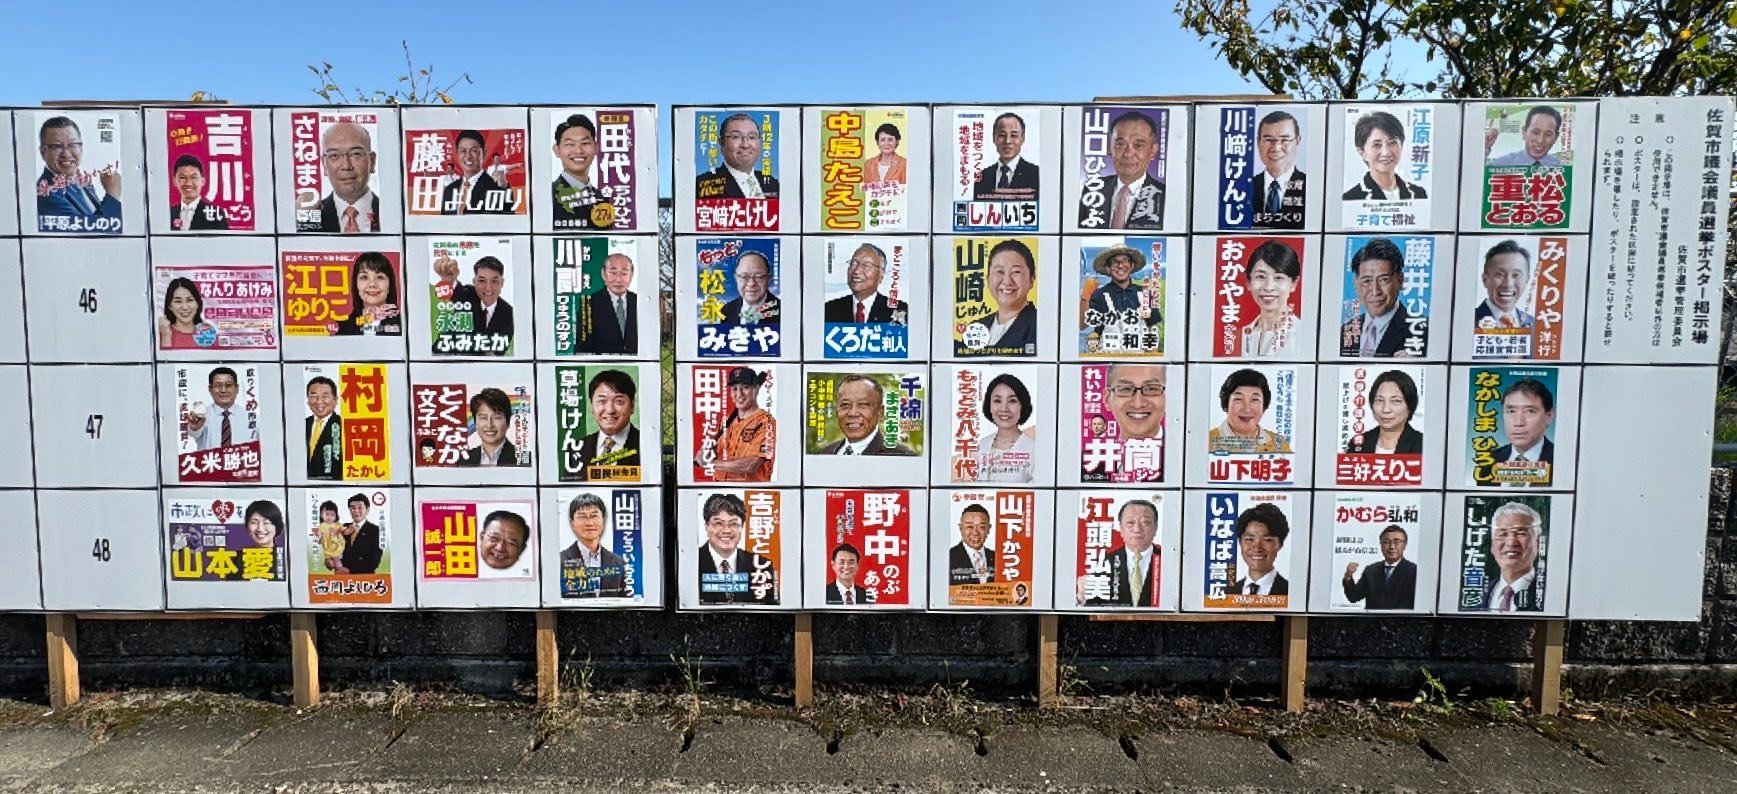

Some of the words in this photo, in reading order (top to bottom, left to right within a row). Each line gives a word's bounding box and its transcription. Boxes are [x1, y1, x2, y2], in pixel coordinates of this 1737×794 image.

[205, 113, 245, 203] 吉川
[294, 116, 320, 208] さねまつ
[972, 121, 984, 183] 地域をつくり
[1409, 108, 1431, 182] 江原新子
[410, 133, 447, 212] 藤田
[600, 124, 632, 228] 田代ちかひさ
[823, 111, 865, 230] 中島たえこ
[1080, 109, 1110, 228] 山口ひろのぶ
[444, 189, 523, 212] よしのり
[1489, 173, 1566, 203] 重松
[44, 216, 122, 231] 平原よしのり
[203, 204, 252, 221] せいごう
[969, 203, 1037, 227] しんいち
[1252, 212, 1302, 223] まちづくり
[1356, 214, 1415, 227] 子育て福祉
[1485, 202, 1565, 225] とおる
[1691, 108, 1724, 345] 佐賀市議会議員選挙ポスター掲示場
[200, 282, 233, 298] なんり
[236, 281, 273, 298] あけみ
[285, 263, 350, 296] 江口
[700, 269, 727, 324] 松永
[1219, 240, 1246, 323] おかやま
[1671, 244, 1688, 348] 佐賀市選挙管理委員会
[79, 288, 98, 313] 46
[287, 298, 350, 321] ゆりこ
[955, 302, 992, 319] じゅん
[1402, 238, 1432, 357] 藤井ひでき
[1084, 308, 1140, 327] なかお
[438, 333, 510, 353] ふみたか
[700, 326, 780, 354] みきや
[825, 325, 907, 355] くろだ利人
[1122, 333, 1159, 350] 和幸
[900, 377, 922, 420] 千綿
[1084, 368, 1102, 402] れいわ
[1473, 371, 1503, 433] なかしま
[341, 367, 386, 462] 村岡
[417, 388, 438, 428] 文子
[560, 369, 584, 474] 草場けんじ
[85, 414, 104, 439] 47
[438, 386, 472, 465] とくなが
[954, 369, 980, 482] もろとみ八千代
[181, 450, 260, 476] 久米勝也
[1083, 437, 1164, 472] 井筒
[1210, 459, 1292, 482] 山下明子
[1337, 460, 1421, 482] 三好えりこ
[1471, 436, 1497, 483] ひろし
[346, 465, 385, 479] たかし
[1134, 468, 1162, 483] ジン
[863, 492, 902, 565] 野中
[1336, 505, 1419, 525] かむら弘和
[93, 539, 112, 562] 48
[425, 529, 442, 577] 誠一郎
[444, 512, 477, 576] 山田
[747, 493, 776, 601] 吉野としかず
[999, 494, 1024, 582] 山下かつや
[1084, 496, 1115, 601] 江頭弘美
[172, 547, 275, 580] 山本愛
[563, 566, 620, 579] 地域のために
[882, 564, 900, 596] のぶ
[864, 569, 880, 604] あき
